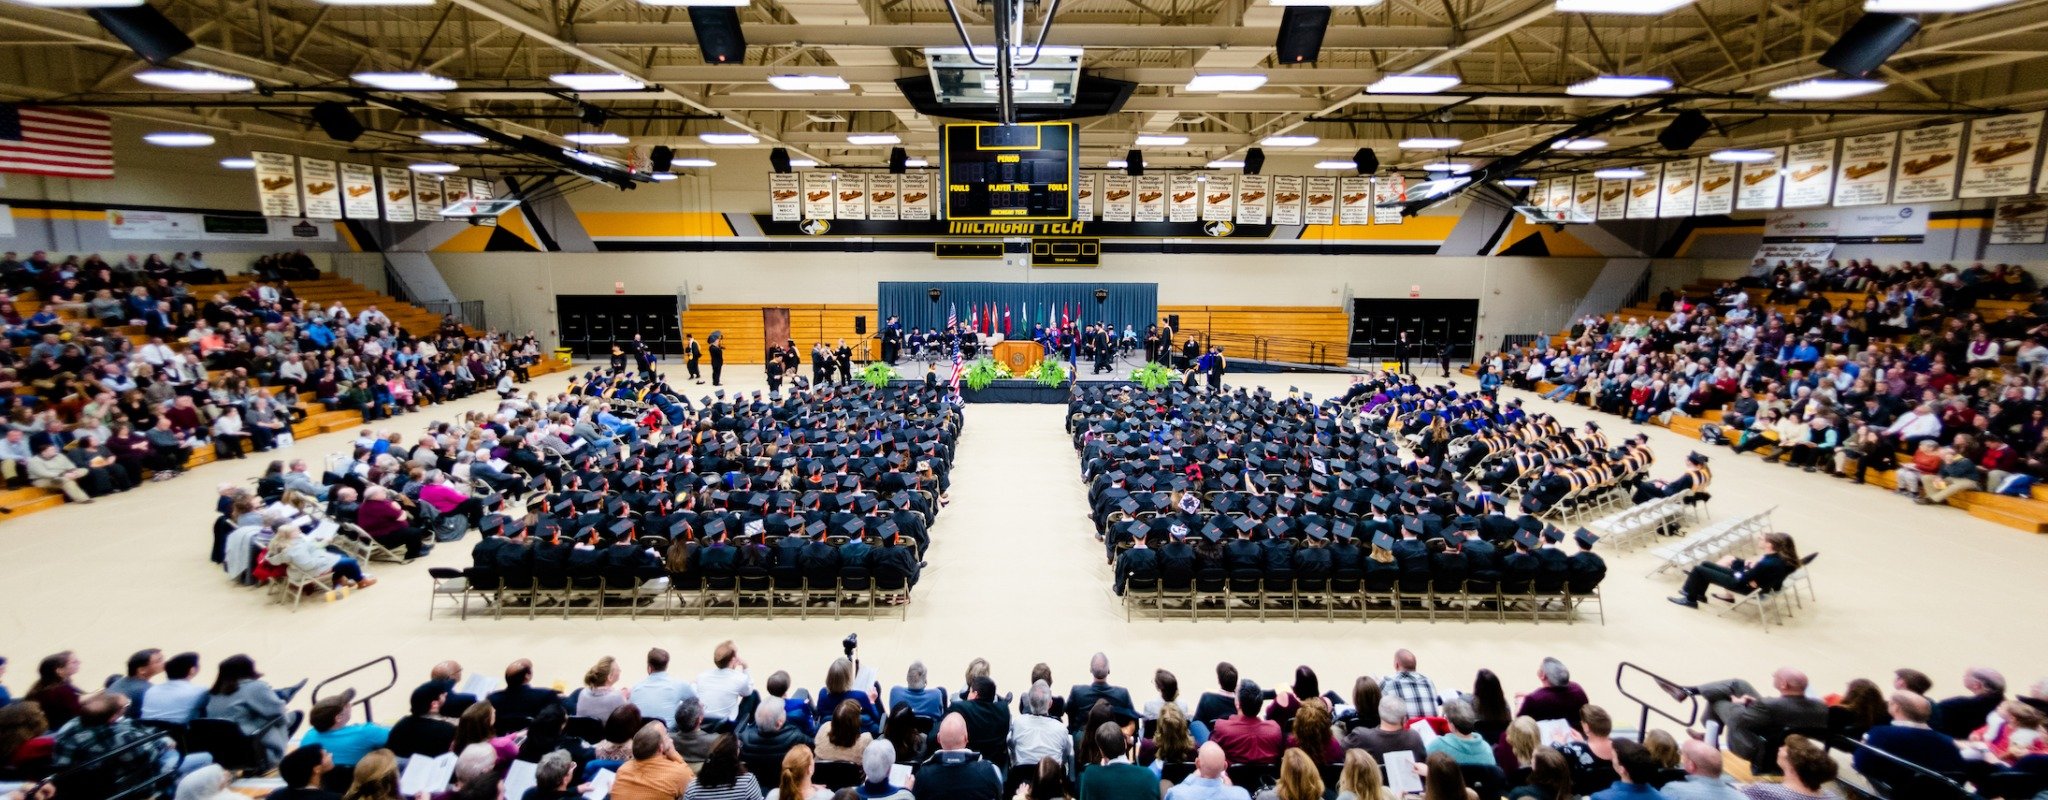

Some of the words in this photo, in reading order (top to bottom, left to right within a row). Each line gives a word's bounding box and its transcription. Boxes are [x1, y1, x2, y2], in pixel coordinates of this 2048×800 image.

[997, 154, 1020, 163] PERIOD
[950, 184, 970, 192] FOULS
[988, 184, 1011, 192] PLAYER
[1014, 183, 1030, 192] FOUL
[949, 221, 1035, 234] MICHIGAN
[1042, 221, 1084, 234] TECH
